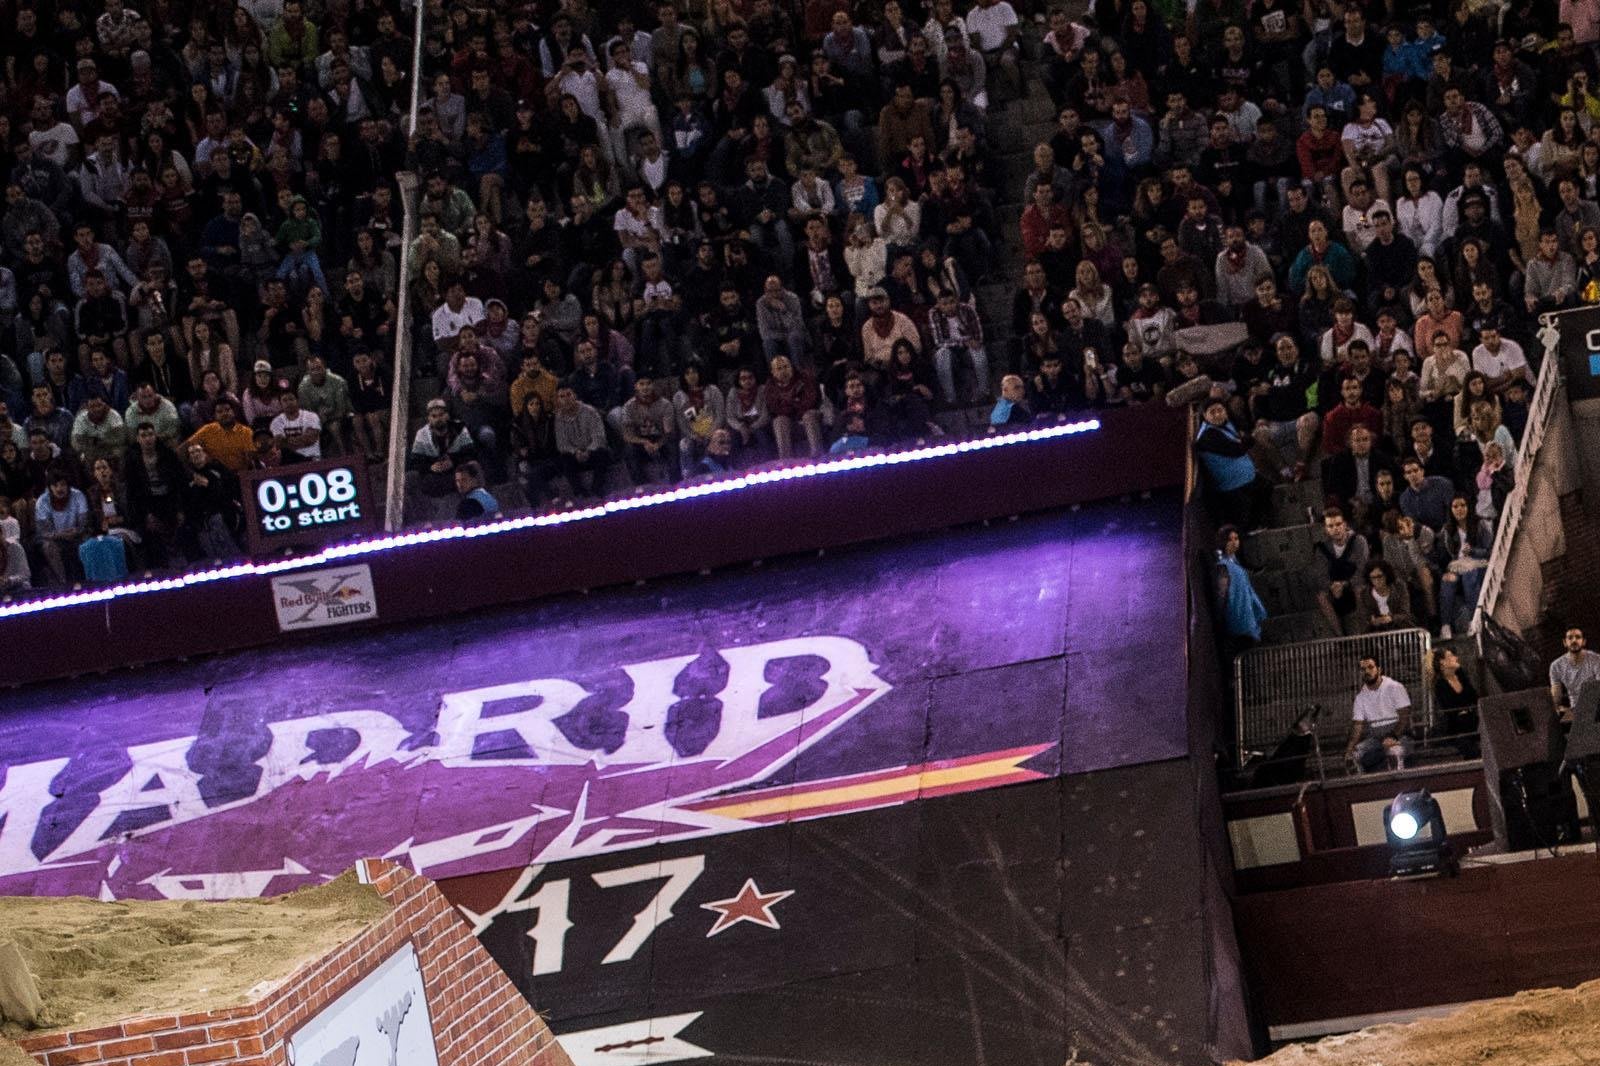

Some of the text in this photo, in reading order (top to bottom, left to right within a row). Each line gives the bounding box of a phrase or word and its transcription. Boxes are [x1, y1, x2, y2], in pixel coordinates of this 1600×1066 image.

[257, 468, 357, 513] 0:08
[262, 502, 361, 531] to start
[280, 595, 303, 609] Red
[327, 601, 372, 619] FIGHTERS
